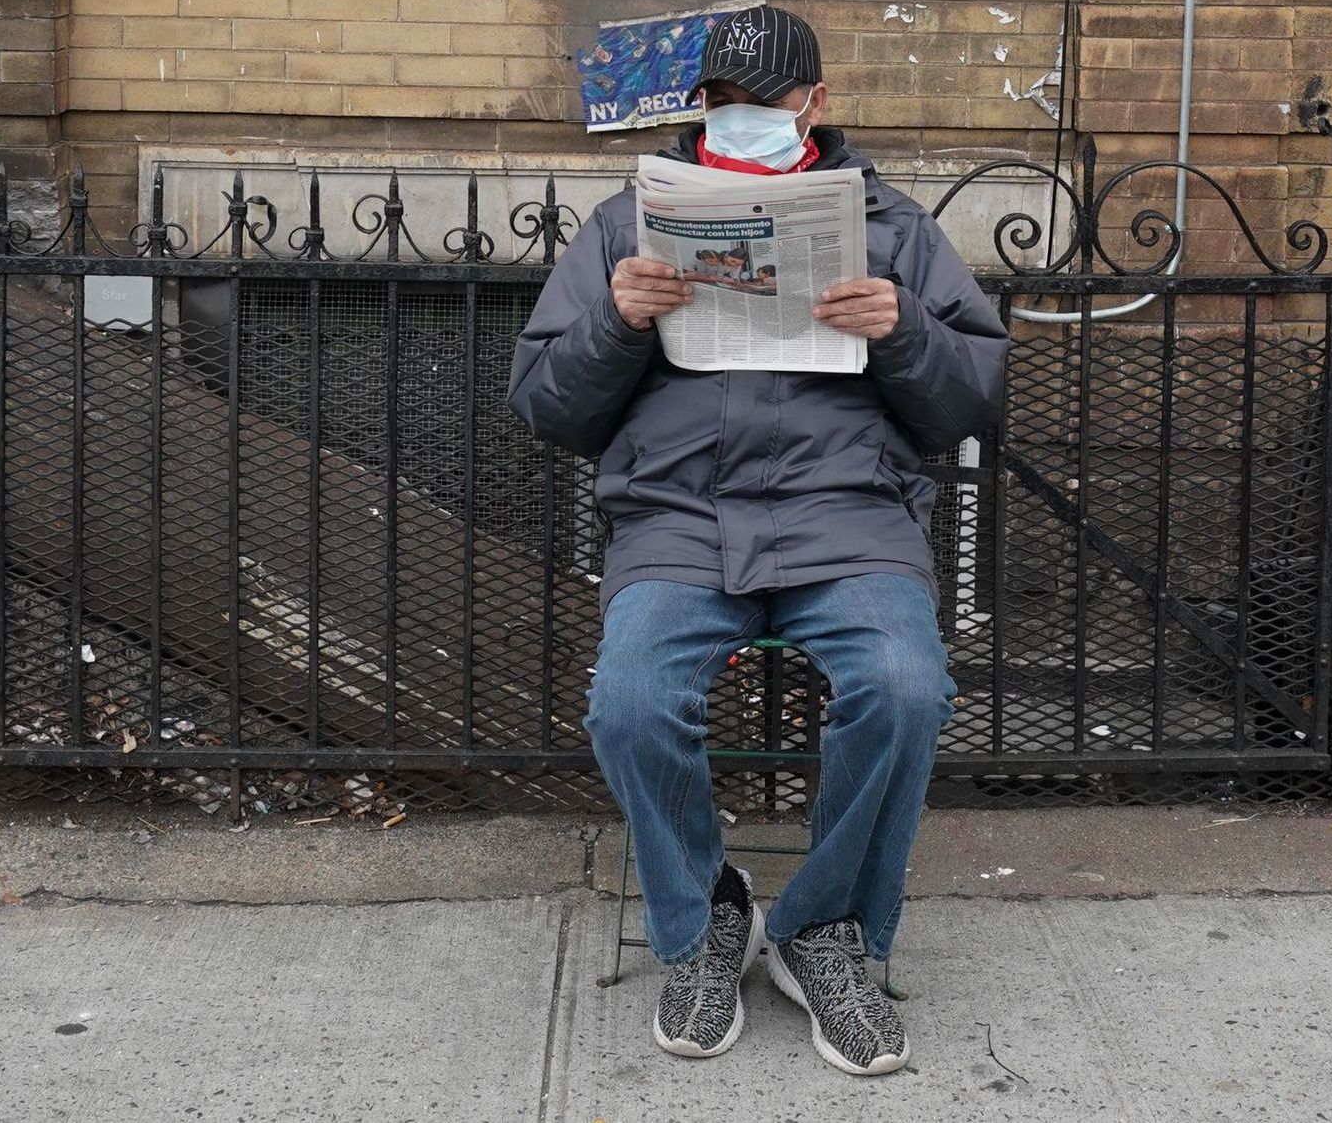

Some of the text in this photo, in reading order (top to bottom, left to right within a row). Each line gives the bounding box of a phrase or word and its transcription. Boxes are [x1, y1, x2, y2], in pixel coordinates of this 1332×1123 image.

[589, 101, 618, 122] NY
[653, 223, 664, 231] de
[665, 226, 706, 237] conectar
[725, 229, 740, 237] los
[741, 229, 765, 238] hijos
[657, 218, 710, 230] cuarentena
[712, 222, 722, 230] es
[723, 220, 771, 230] momento
